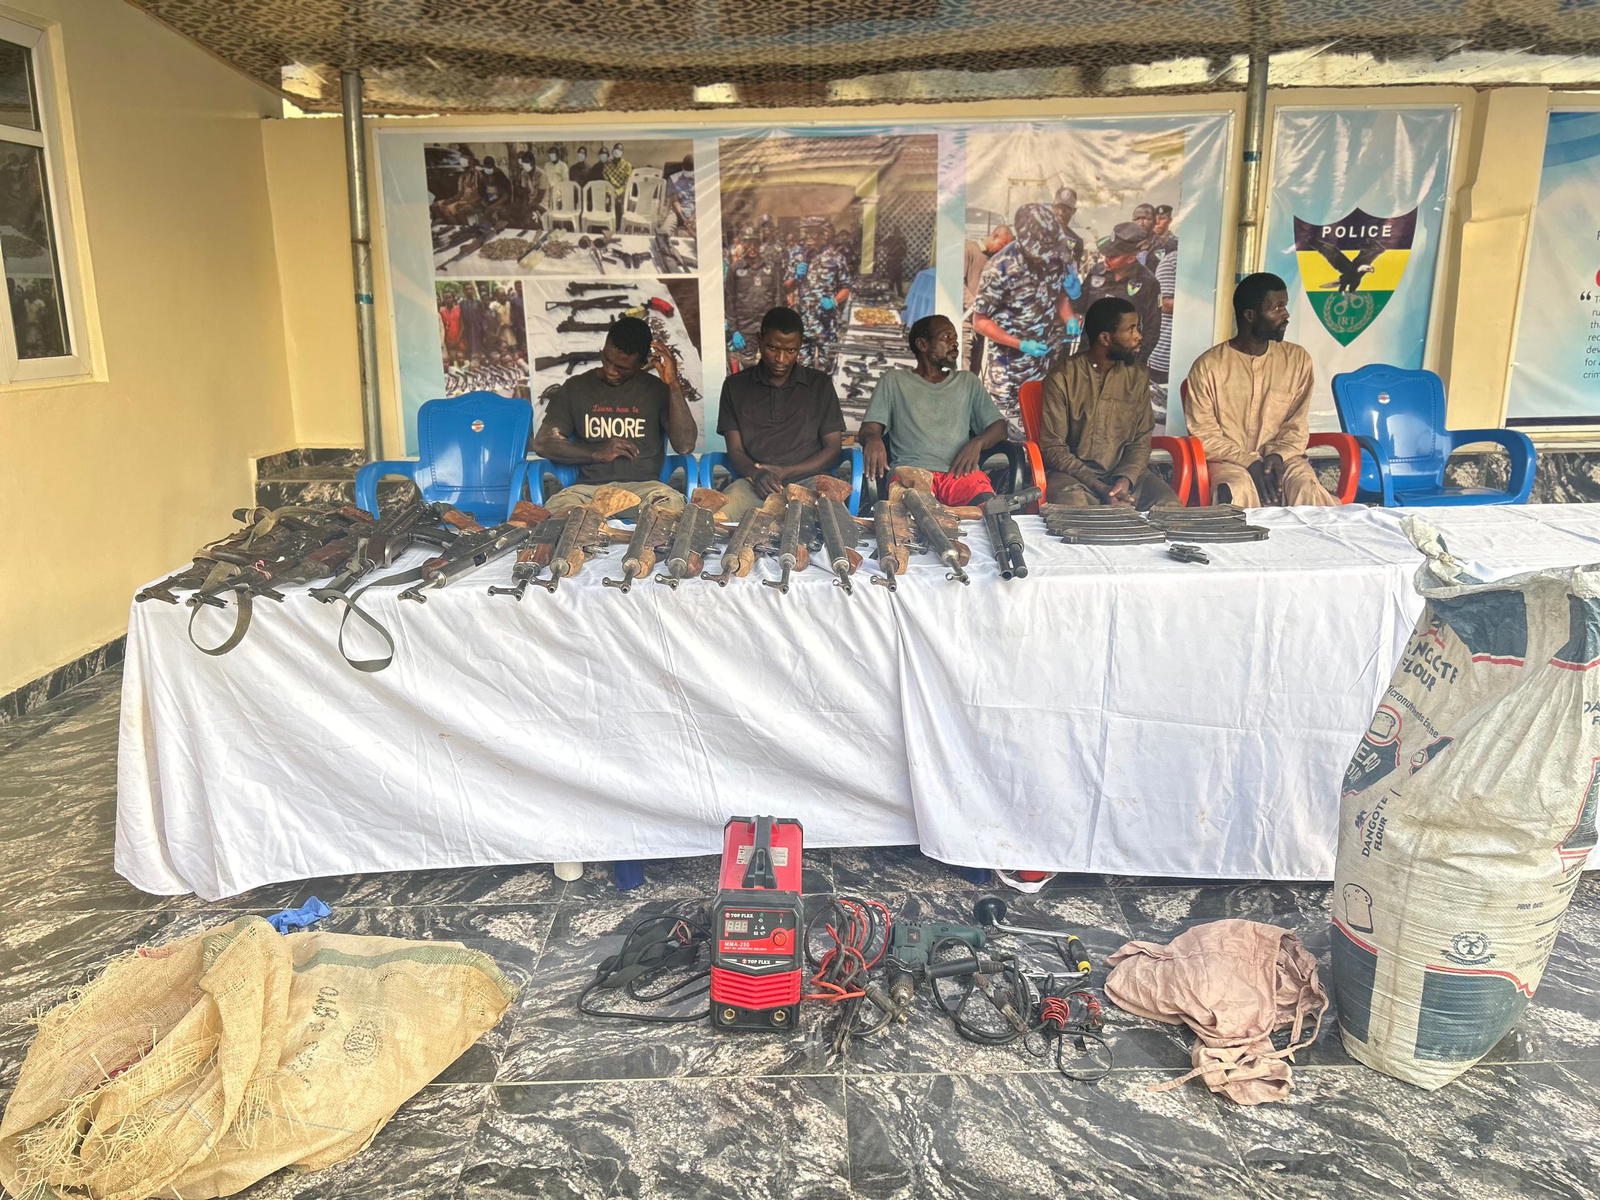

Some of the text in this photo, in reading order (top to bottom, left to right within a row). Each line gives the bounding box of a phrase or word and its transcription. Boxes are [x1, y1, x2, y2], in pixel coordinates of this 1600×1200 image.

[1322, 225, 1392, 238] POLICE
[1585, 358, 1596, 366] for
[585, 413, 646, 438] IGNORE
[1362, 796, 1389, 857] DANGOTE
[1374, 817, 1388, 851] FLOUR
